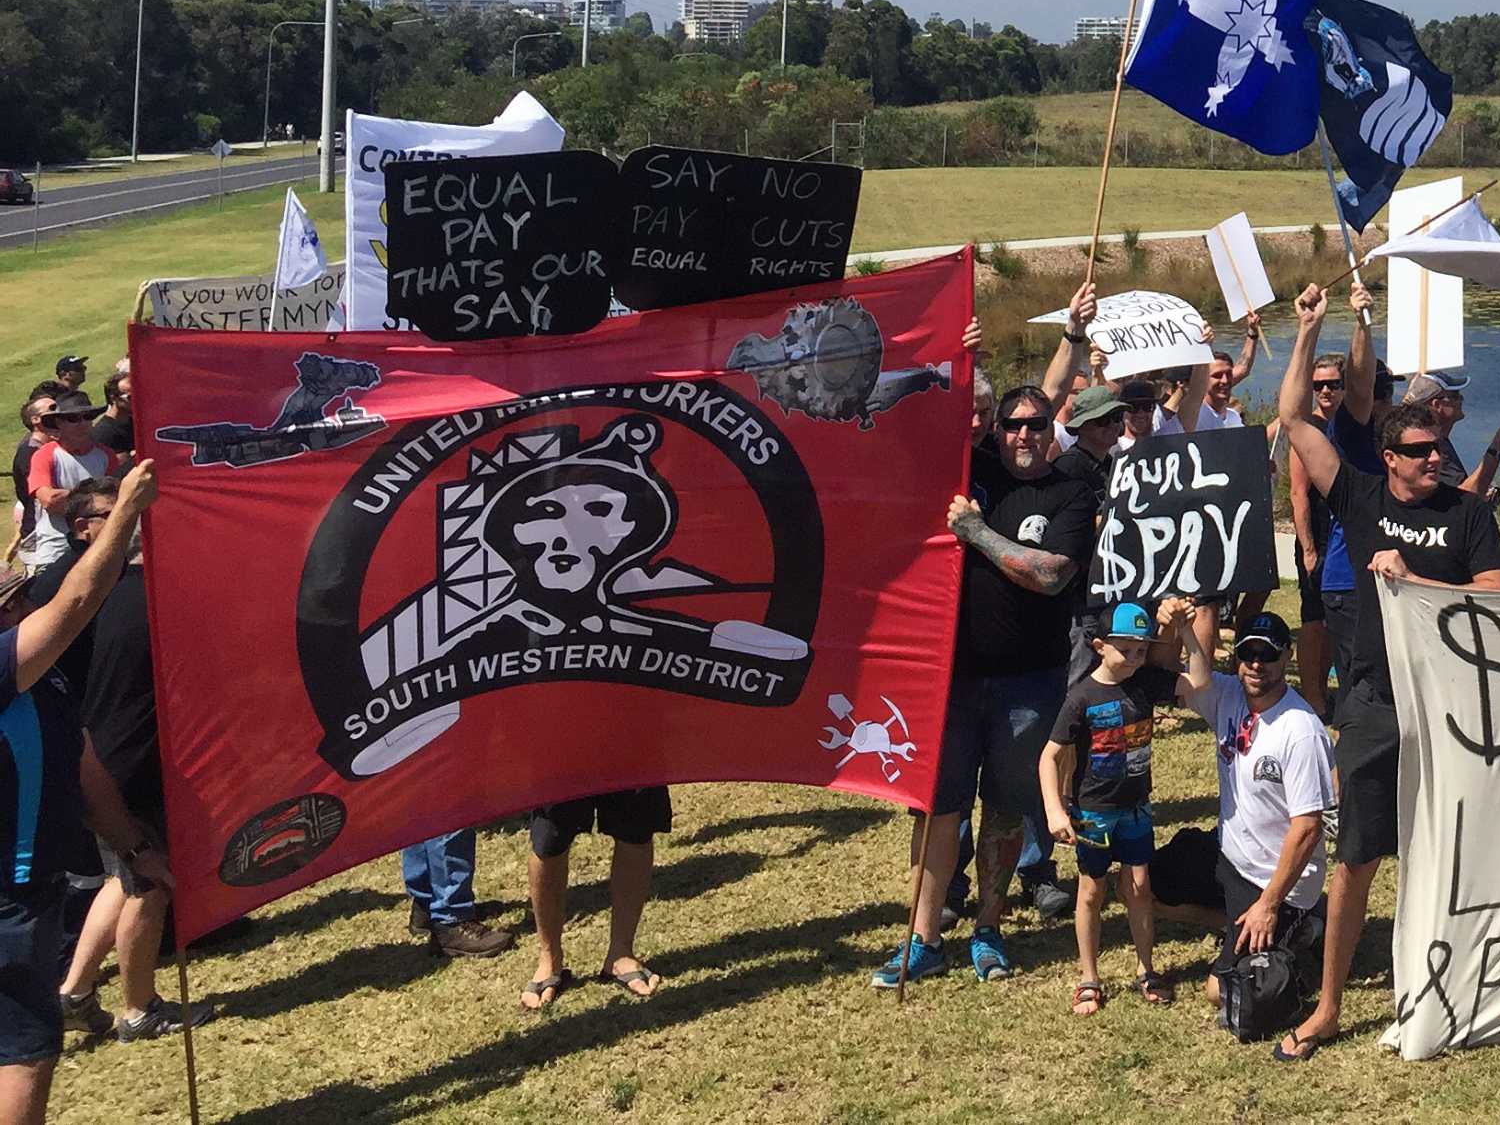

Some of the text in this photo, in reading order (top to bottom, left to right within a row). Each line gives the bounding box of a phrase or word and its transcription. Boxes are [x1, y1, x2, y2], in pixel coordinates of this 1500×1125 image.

[402, 172, 579, 216] EQUAL
[645, 153, 822, 200] SAY NO
[442, 211, 532, 256] PAY
[632, 204, 846, 248] PAY CUTS
[393, 249, 607, 299] THATS OUR
[631, 247, 835, 277] EQUAL RIGHTS
[453, 283, 551, 335] SAY
[1090, 313, 1208, 355] CHRISTMAS
[353, 413, 485, 514] UNITED
[343, 644, 785, 741] SOUTH WESTERN DISTRICT
